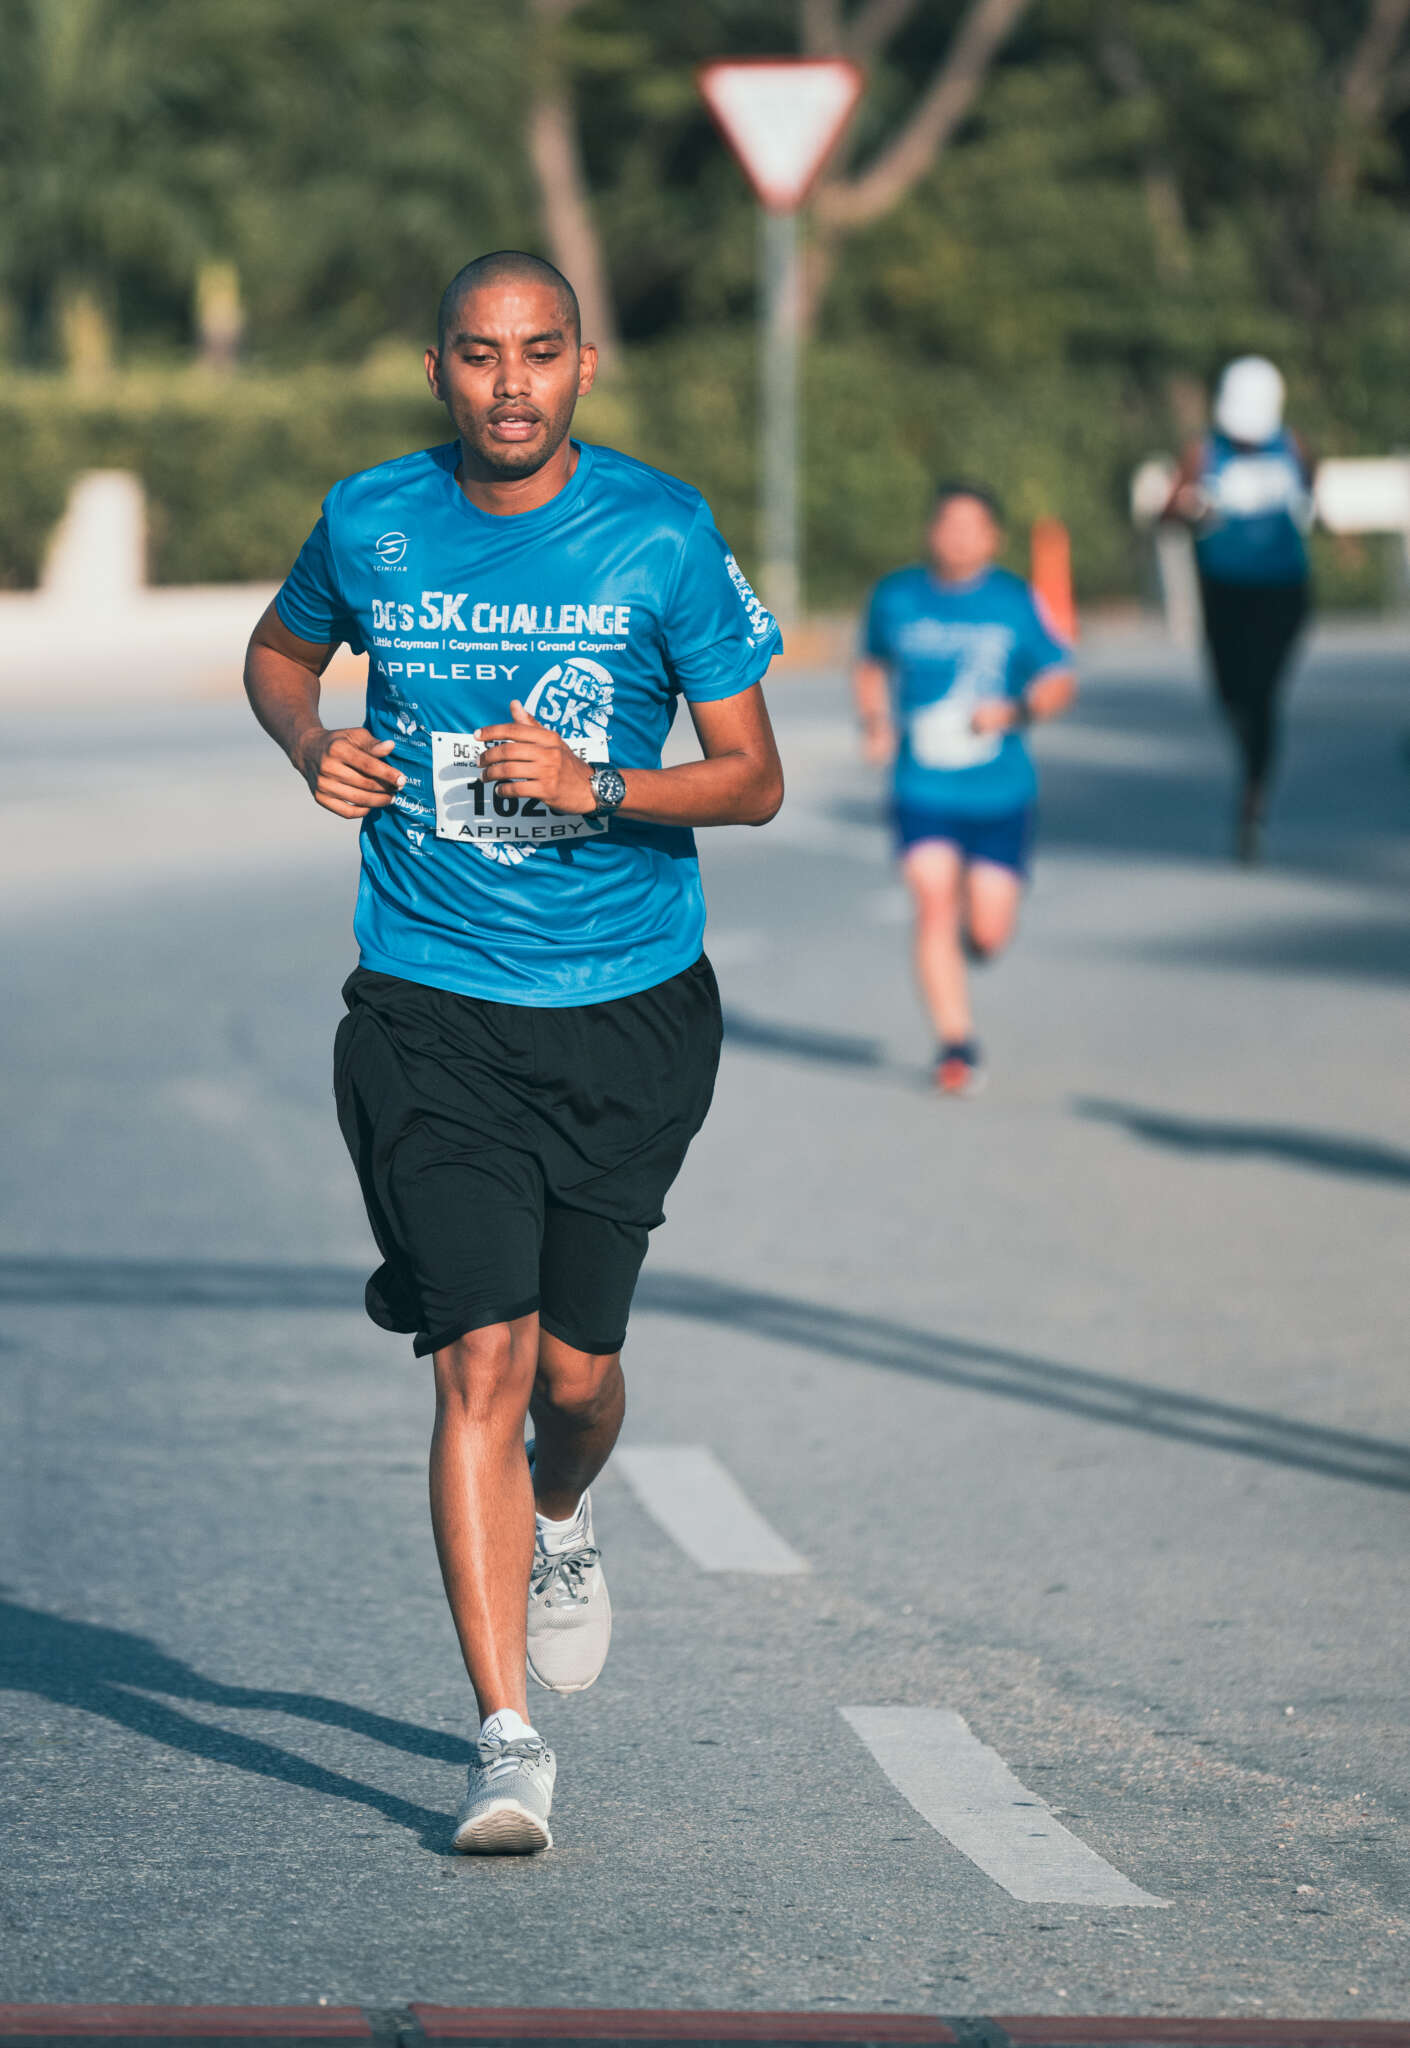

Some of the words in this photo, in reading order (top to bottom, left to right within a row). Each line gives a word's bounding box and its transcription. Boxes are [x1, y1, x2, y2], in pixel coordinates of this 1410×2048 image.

[419, 591, 469, 631] 5K
[471, 603, 631, 635] CHALLENGE
[373, 636, 392, 648] Little
[393, 638, 439, 651] Cayman
[449, 639, 499, 652] Cayman
[501, 640, 528, 652] Brac
[537, 640, 576, 652] Grand
[578, 640, 627, 653] Cayman
[377, 660, 520, 681] APPLEBY
[539, 686, 591, 731] 5K
[467, 778, 566, 818] 162
[458, 822, 584, 839] APPLEBY
